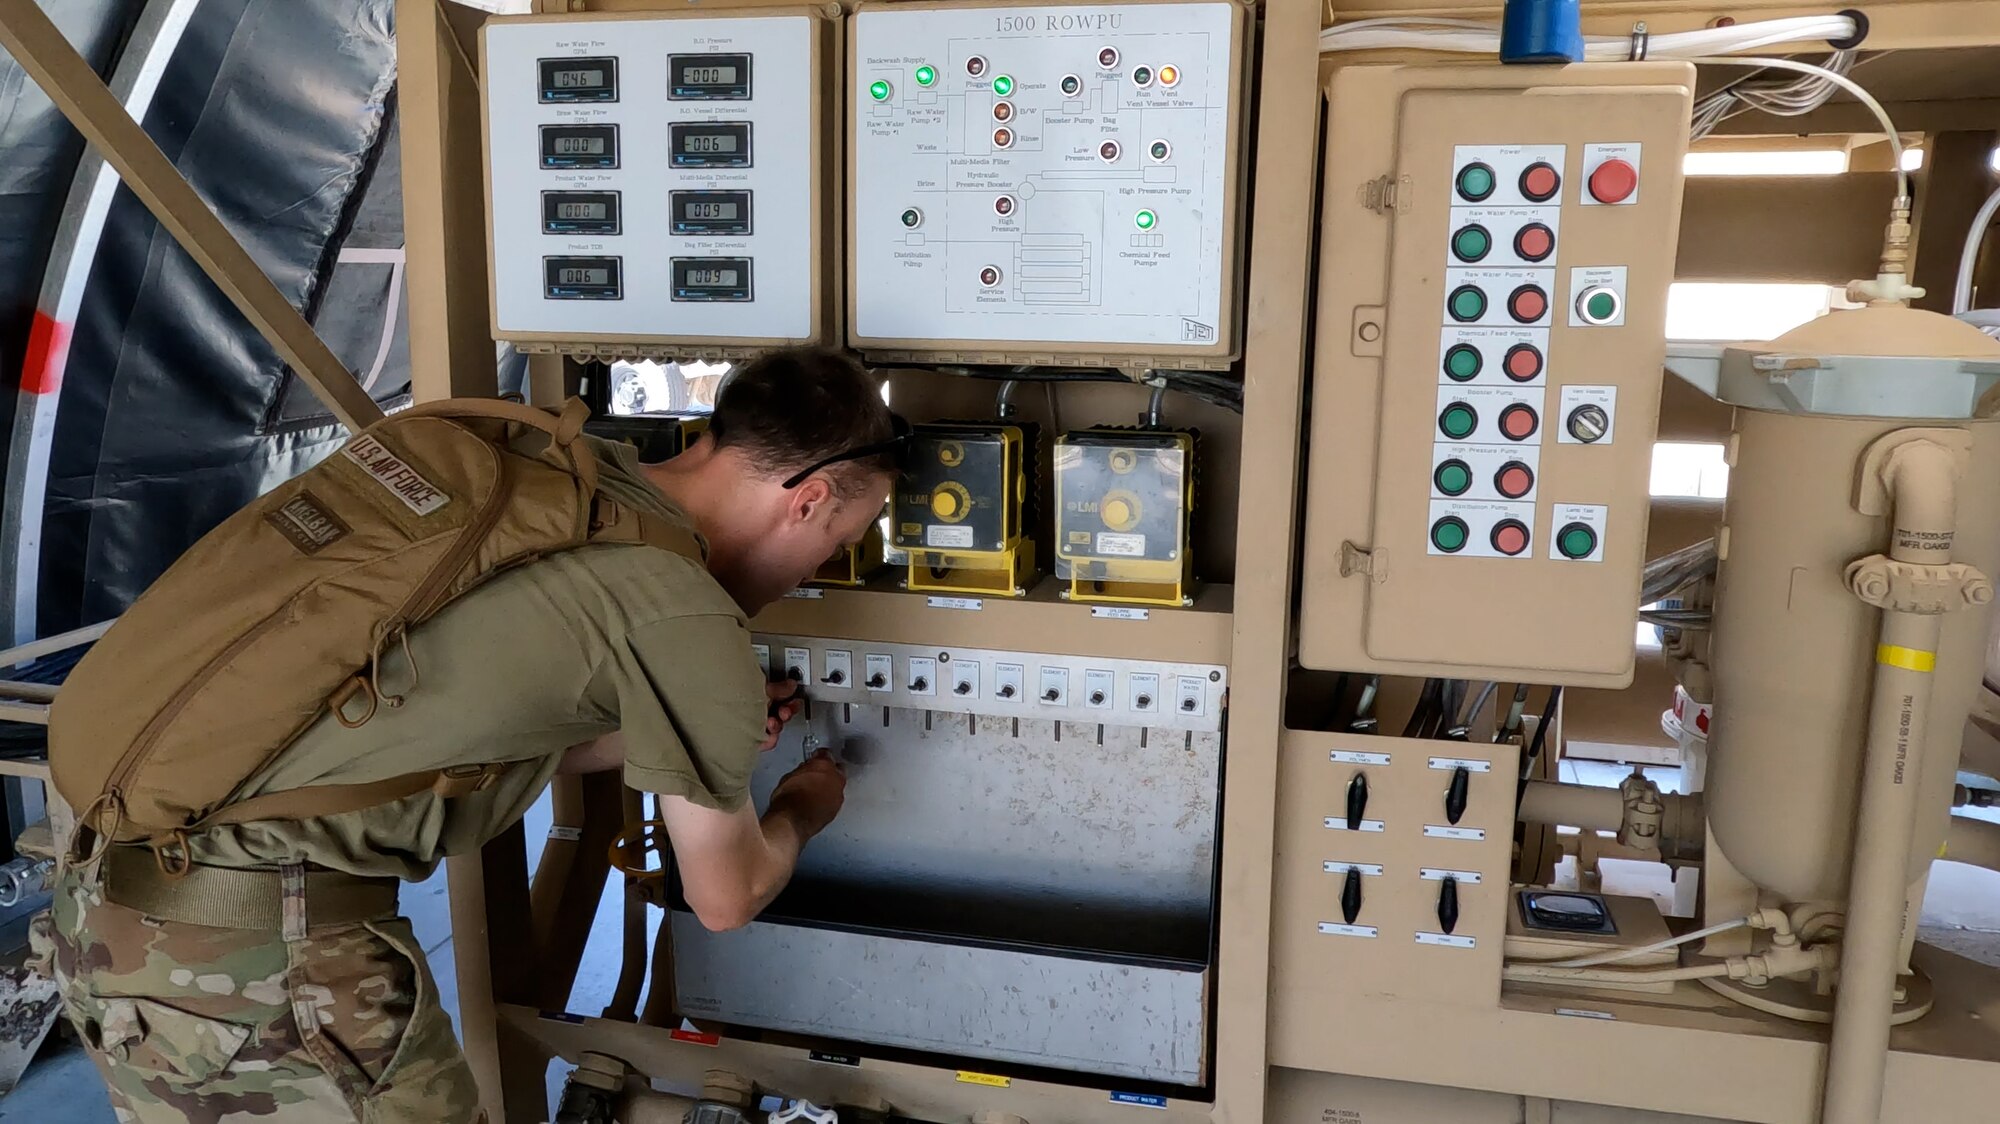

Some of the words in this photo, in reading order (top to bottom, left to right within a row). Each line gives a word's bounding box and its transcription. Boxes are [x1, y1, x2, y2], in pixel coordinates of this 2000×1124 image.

[996, 16, 1036, 32] 1500
[1046, 13, 1123, 31] ROWPU
[563, 72, 587, 86] 046
[1074, 117, 1095, 125] Pump
[564, 139, 589, 152] 000
[967, 171, 999, 179] Hydraulic
[566, 205, 590, 218] 000
[694, 204, 720, 217] 009
[567, 270, 591, 282] 006
[695, 271, 720, 283] 009
[351, 438, 381, 463] U.S.
[370, 457, 394, 481] AIR
[386, 468, 441, 507] FORCE
[909, 494, 928, 505] LMI
[1077, 502, 1098, 513] LMI
[1900, 540, 1920, 549] MFR
[1119, 1094, 1140, 1102] PRODUCT
[1141, 1096, 1158, 1104] WATER
